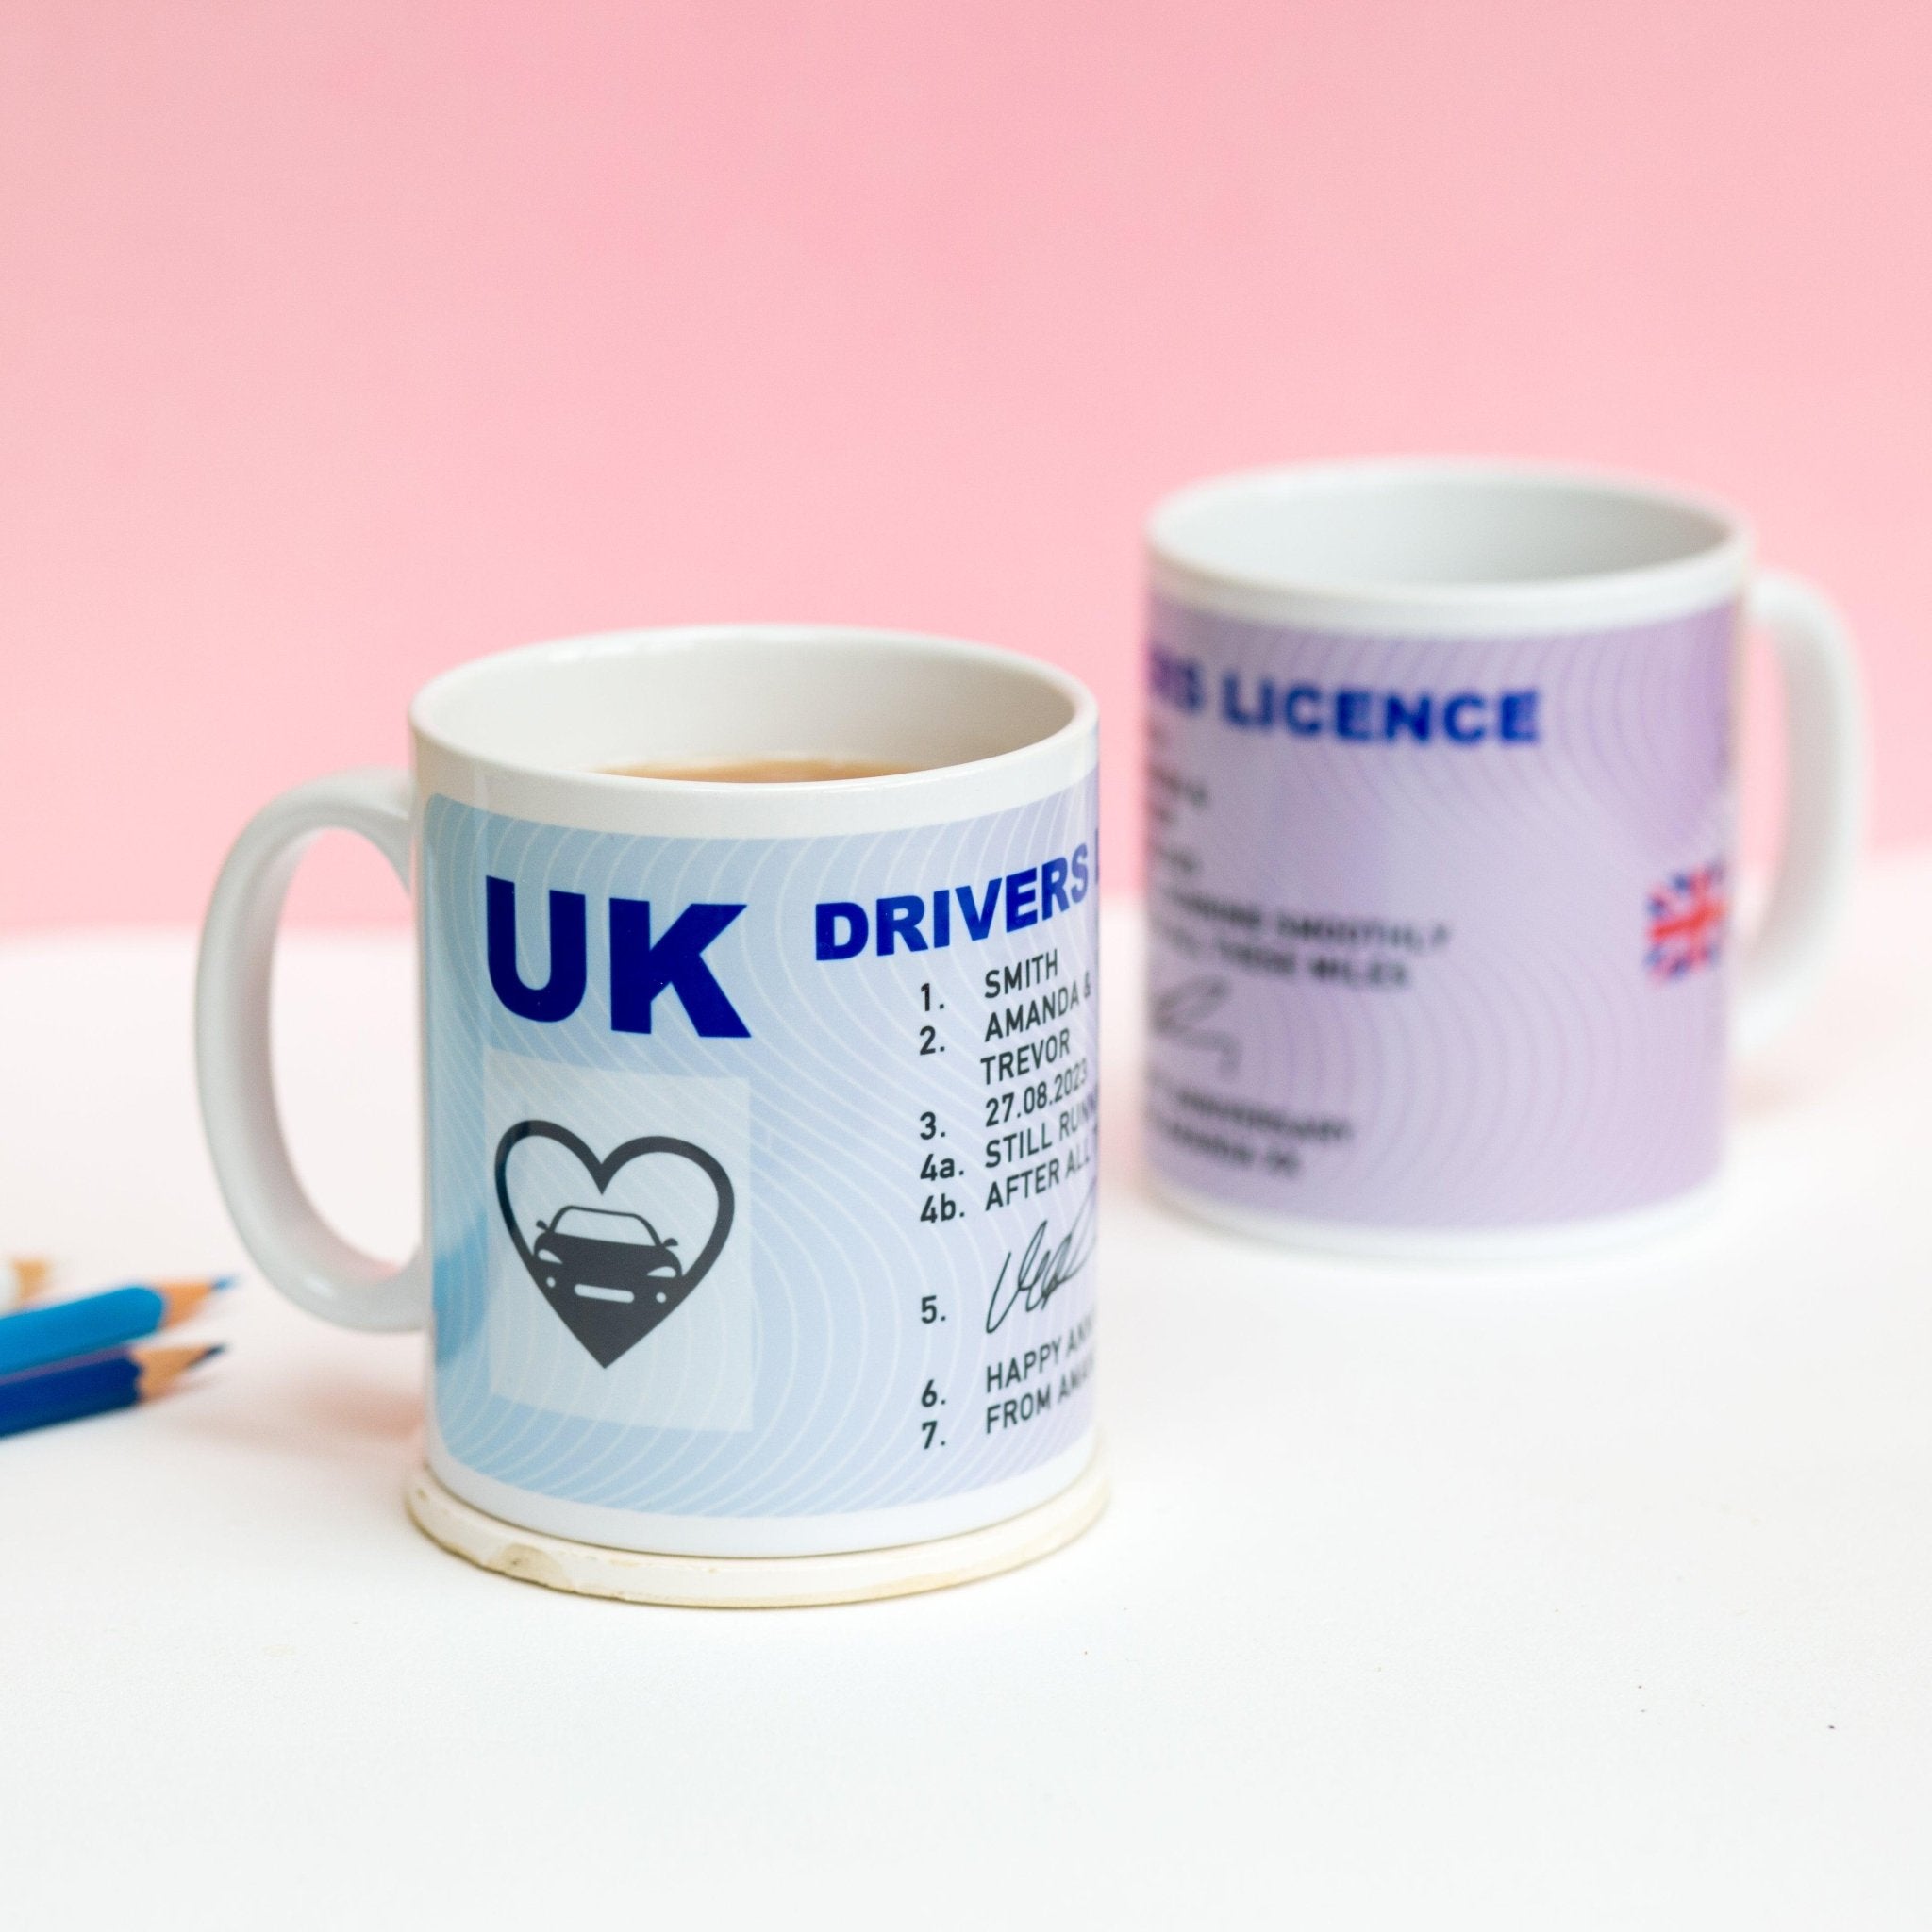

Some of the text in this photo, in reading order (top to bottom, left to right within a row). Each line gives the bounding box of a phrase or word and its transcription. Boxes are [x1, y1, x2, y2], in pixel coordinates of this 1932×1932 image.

[1221, 669, 1541, 745] LICENCE
[815, 842, 1089, 962] DRIVERS
[485, 874, 753, 1039] UK
[920, 948, 1058, 1012] 1. SMITH
[919, 1024, 945, 1056] 2.
[984, 979, 1080, 1042] AMANDA
[980, 1026, 1072, 1086] TREVOR
[919, 1110, 946, 1141] 3.
[985, 1057, 1088, 1127] 27.08.2023
[919, 1152, 965, 1182] 4a.
[984, 1122, 1053, 1169] STILL
[919, 1192, 966, 1224] 4b.
[984, 1158, 1060, 1212] AFTER
[920, 1294, 947, 1324] 5.
[920, 1378, 947, 1408] 6.
[985, 1334, 1062, 1394] HAPPY
[921, 1420, 947, 1450] 7.
[985, 1382, 1051, 1435] FROM
